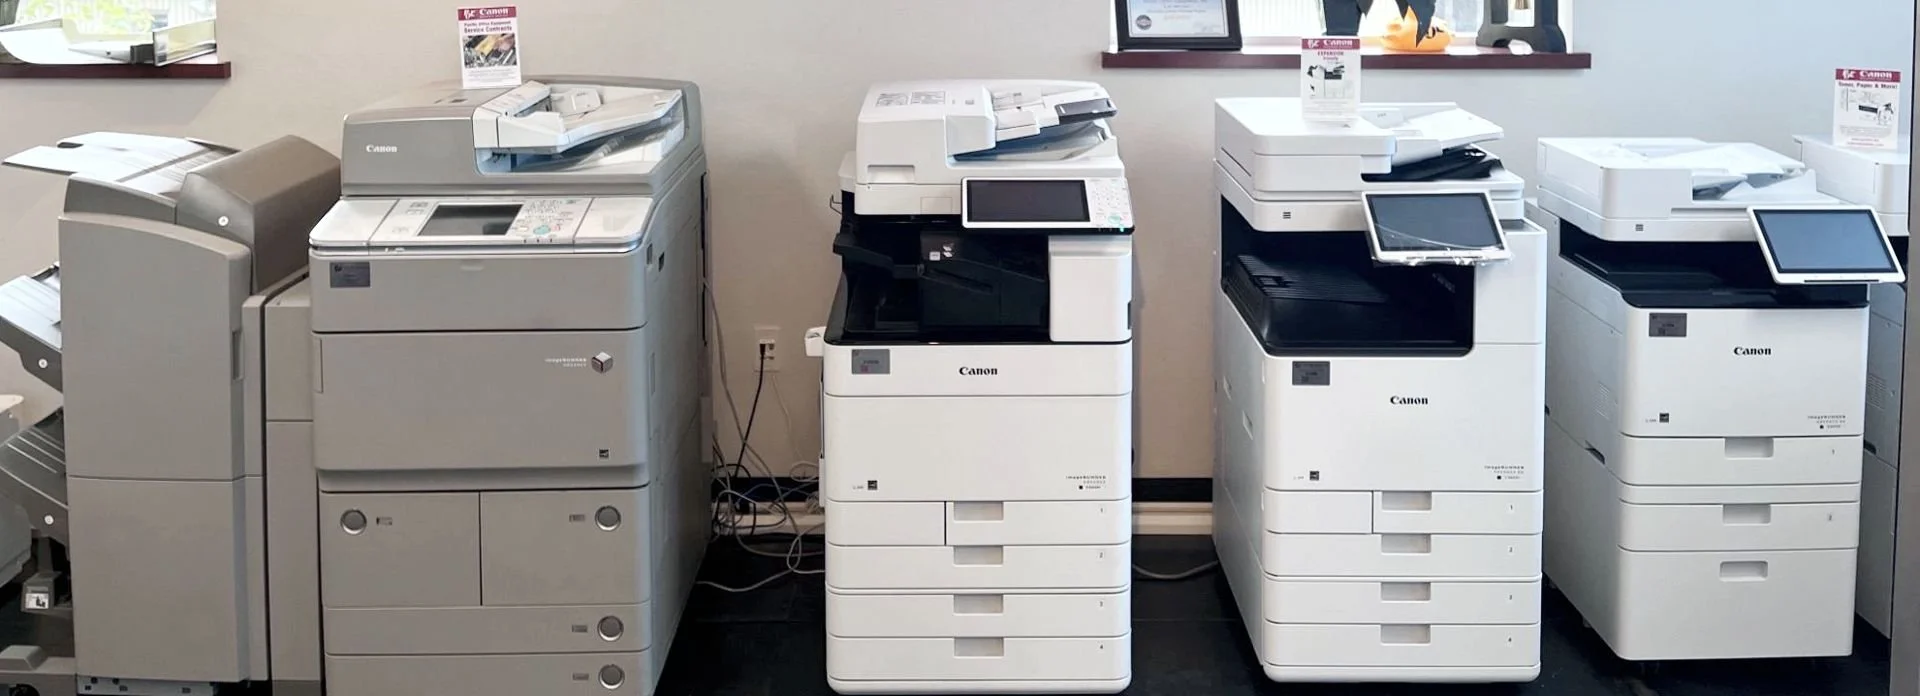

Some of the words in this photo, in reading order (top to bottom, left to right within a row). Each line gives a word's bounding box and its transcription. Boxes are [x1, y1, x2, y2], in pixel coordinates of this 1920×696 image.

[479, 8, 508, 16] Canon
[1859, 70, 1892, 78] Canon
[366, 144, 398, 152] Canon
[1733, 346, 1771, 355] Canon
[959, 366, 998, 375] Canon
[1390, 395, 1428, 405] Canon
